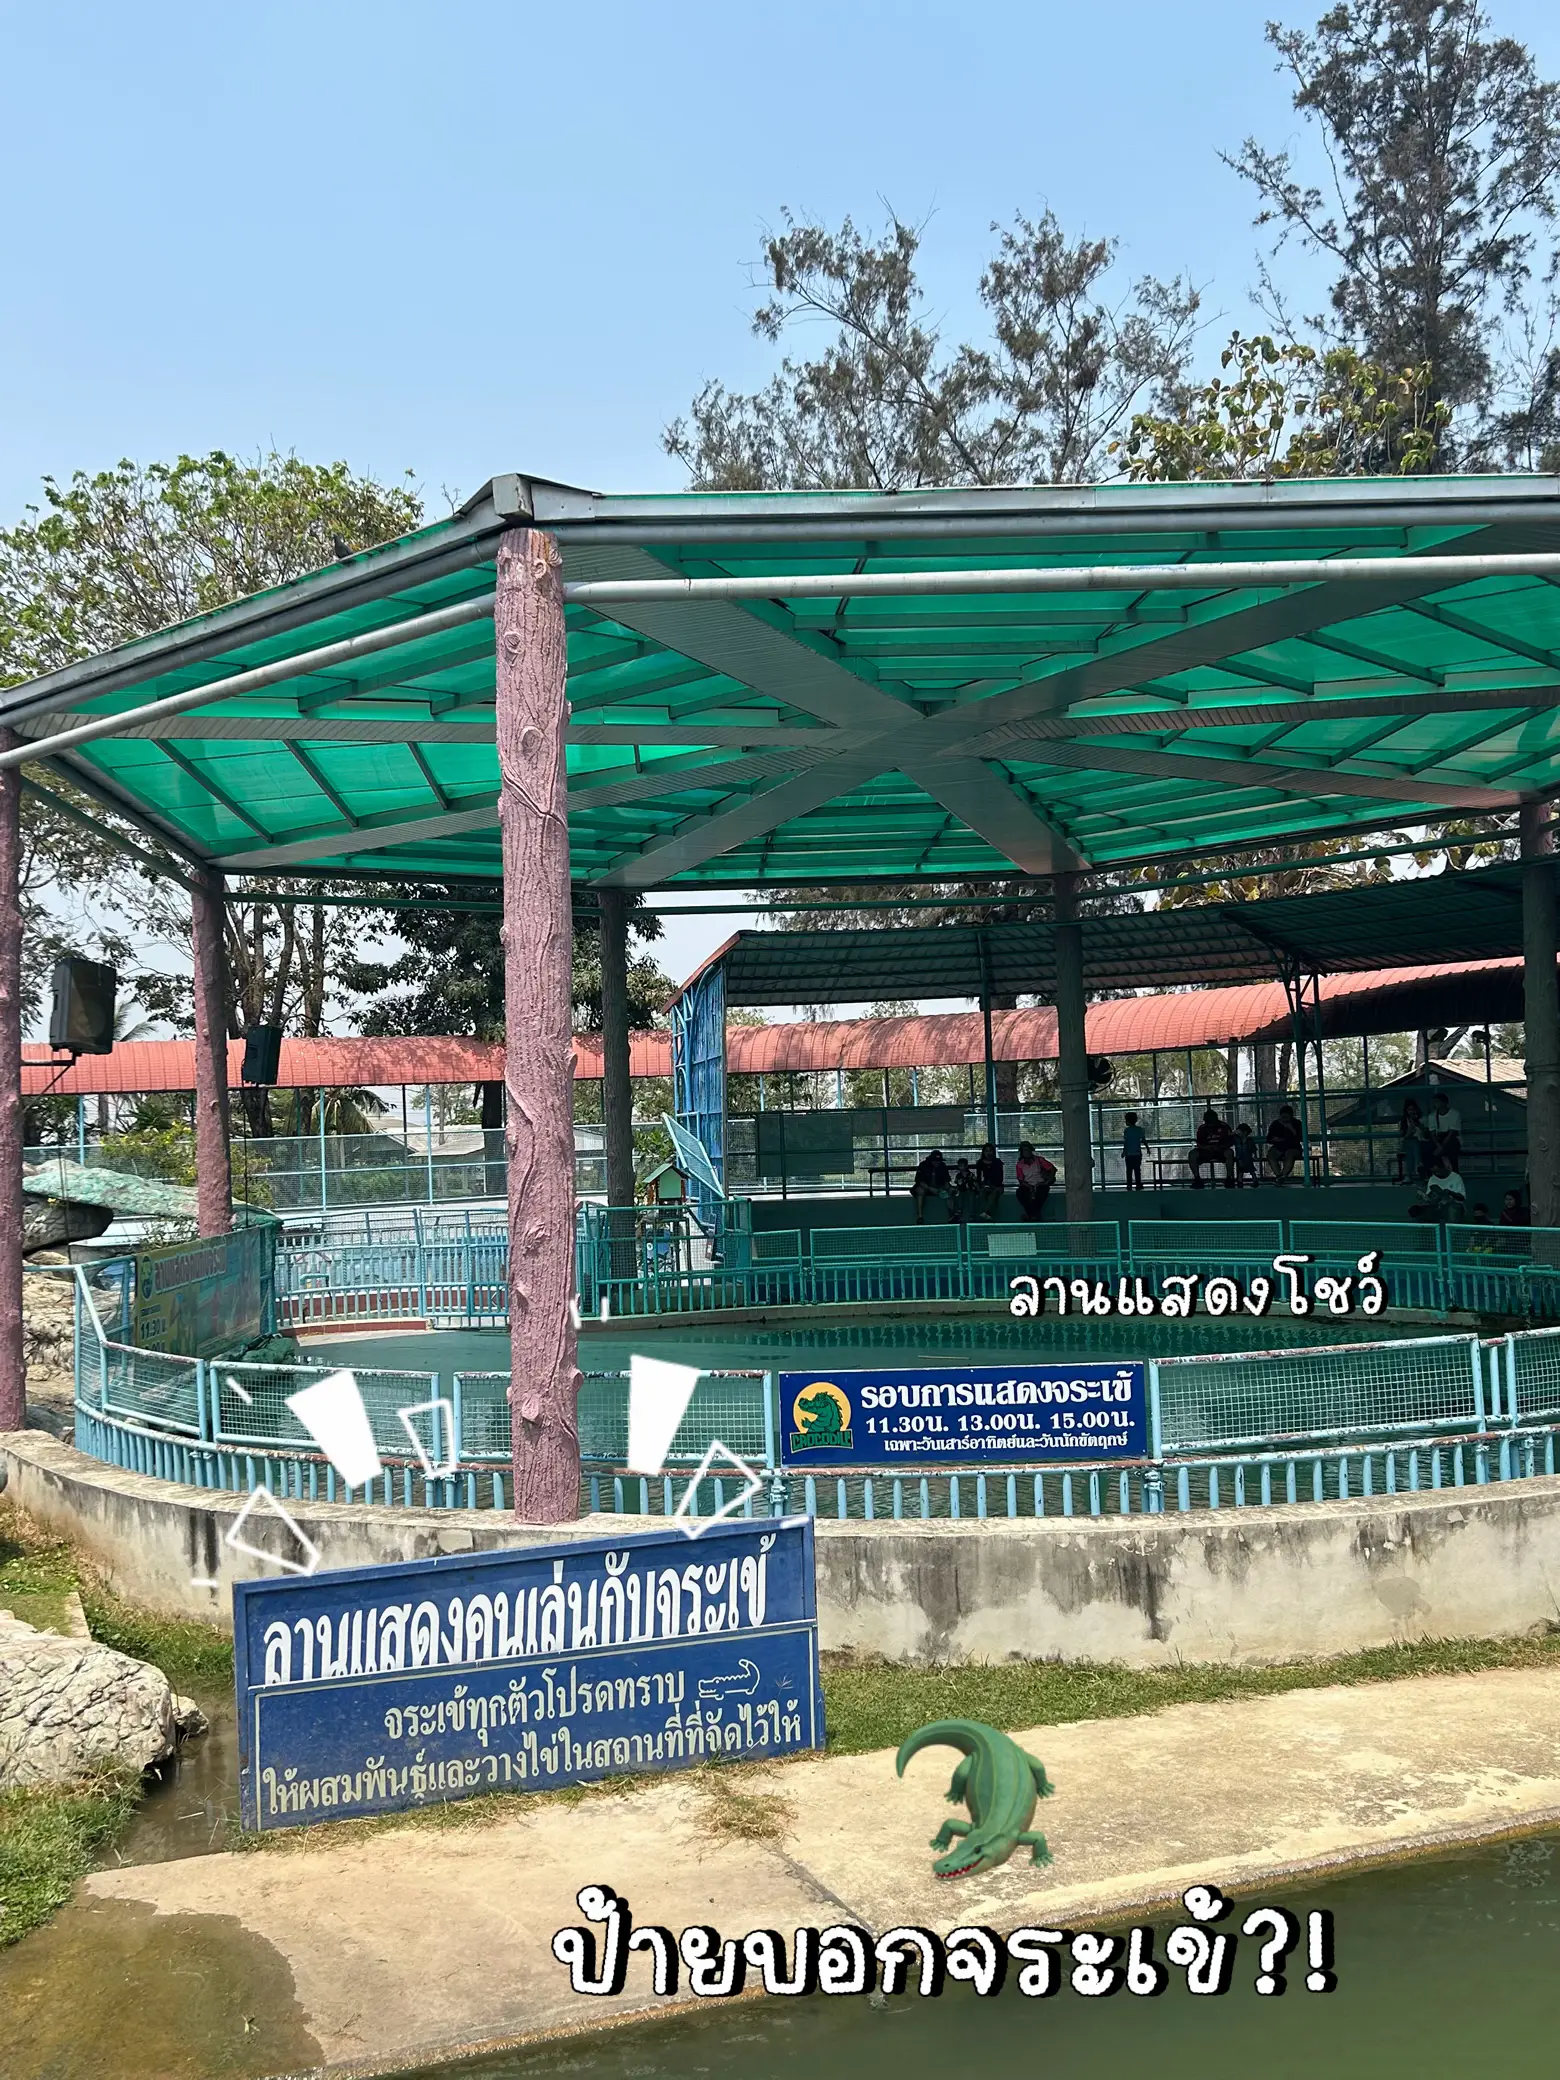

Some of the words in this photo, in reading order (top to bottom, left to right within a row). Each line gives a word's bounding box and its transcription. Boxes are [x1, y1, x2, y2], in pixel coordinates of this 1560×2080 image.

[860, 1370, 1134, 1409] รอบการแสดงจระเข้
[865, 1415, 949, 1434] 11.30น.
[957, 1413, 1041, 1432] 13.00น.
[1049, 1410, 1136, 1430] 15.00น.
[263, 1532, 777, 1685] ลานแสดงคนเล่นกับจระเข้
[384, 1664, 685, 1740] จระเข้ทุกตัวโปรดทราบ
